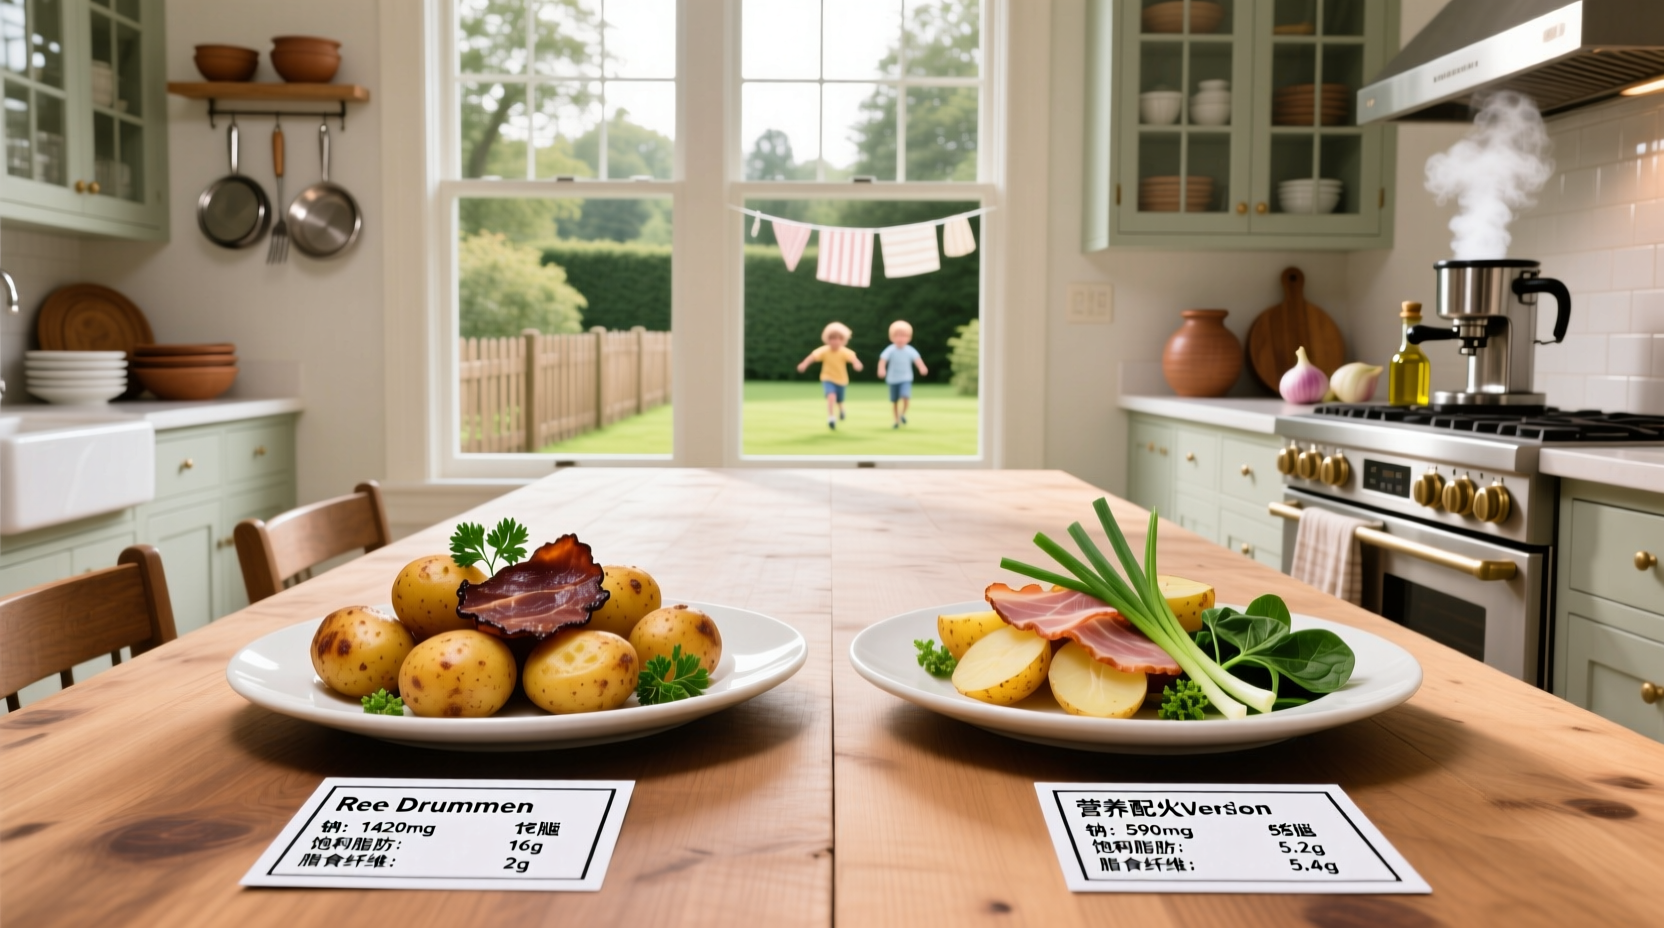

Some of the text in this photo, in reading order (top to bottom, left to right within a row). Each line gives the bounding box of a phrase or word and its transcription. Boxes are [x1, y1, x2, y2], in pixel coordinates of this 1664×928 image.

[336, 796, 533, 813] Ree Drummen
[362, 821, 437, 837] 1420mg
[1126, 823, 1194, 839] 590mg
[510, 840, 543, 854] 16g
[1279, 841, 1325, 856] 5.2g
[503, 857, 530, 873] 2g
[1290, 858, 1339, 875] 5.4g
